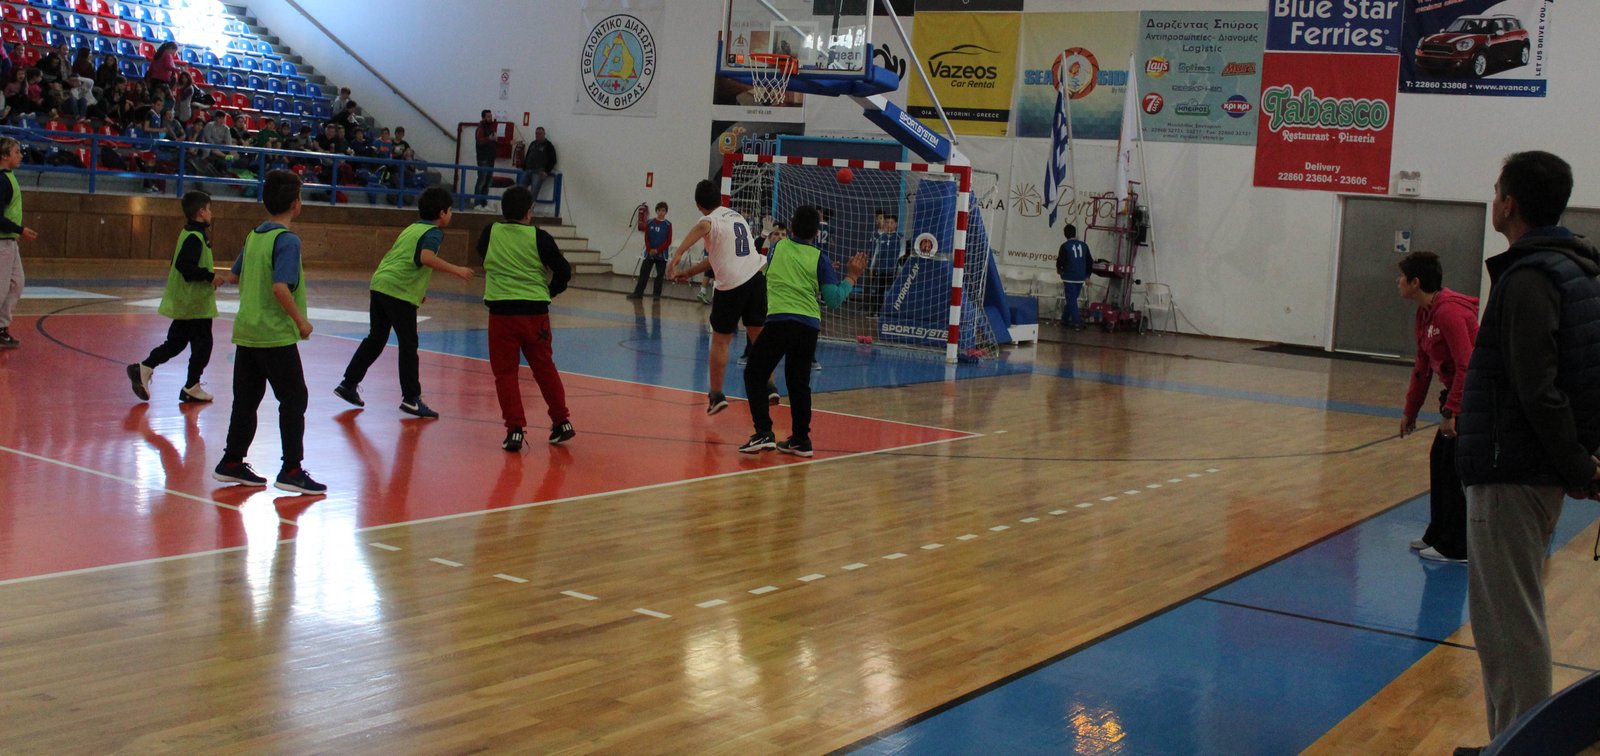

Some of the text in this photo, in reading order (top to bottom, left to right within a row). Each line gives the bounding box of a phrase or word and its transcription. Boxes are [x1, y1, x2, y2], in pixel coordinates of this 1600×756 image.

[1274, 0, 1333, 18] Blue
[1342, 0, 1399, 19] Star
[1290, 21, 1384, 47] Ferries
[1537, 25, 1545, 49] DRIVE
[584, 18, 654, 76] ΕΘΕΛΟΝΤΙΚΟ ΔΙΑΣΩΣΤΙΚΟ
[1182, 44, 1222, 54] Logistic
[1536, 50, 1543, 61] US
[928, 60, 998, 79] Vazeos
[950, 79, 995, 89] Car Rental
[1475, 84, 1541, 93] www.avance.gr
[588, 82, 645, 107] ΣΩΜΑ ΘΗΡΑΣ
[1262, 84, 1389, 132] Tabasco
[1282, 130, 1330, 142] Restaurant
[1338, 132, 1375, 143] Pizzeria
[1305, 162, 1341, 173] Delivery
[1278, 172, 1304, 181] 22860
[1305, 173, 1333, 183] 23604
[1340, 175, 1368, 185] 23606
[734, 221, 750, 257] 8
[1007, 250, 1058, 262] www.pyrgos
[1072, 244, 1083, 258] 11
[894, 263, 920, 311] HYDROPLAY
[881, 323, 949, 339] SPORTSYSTE
